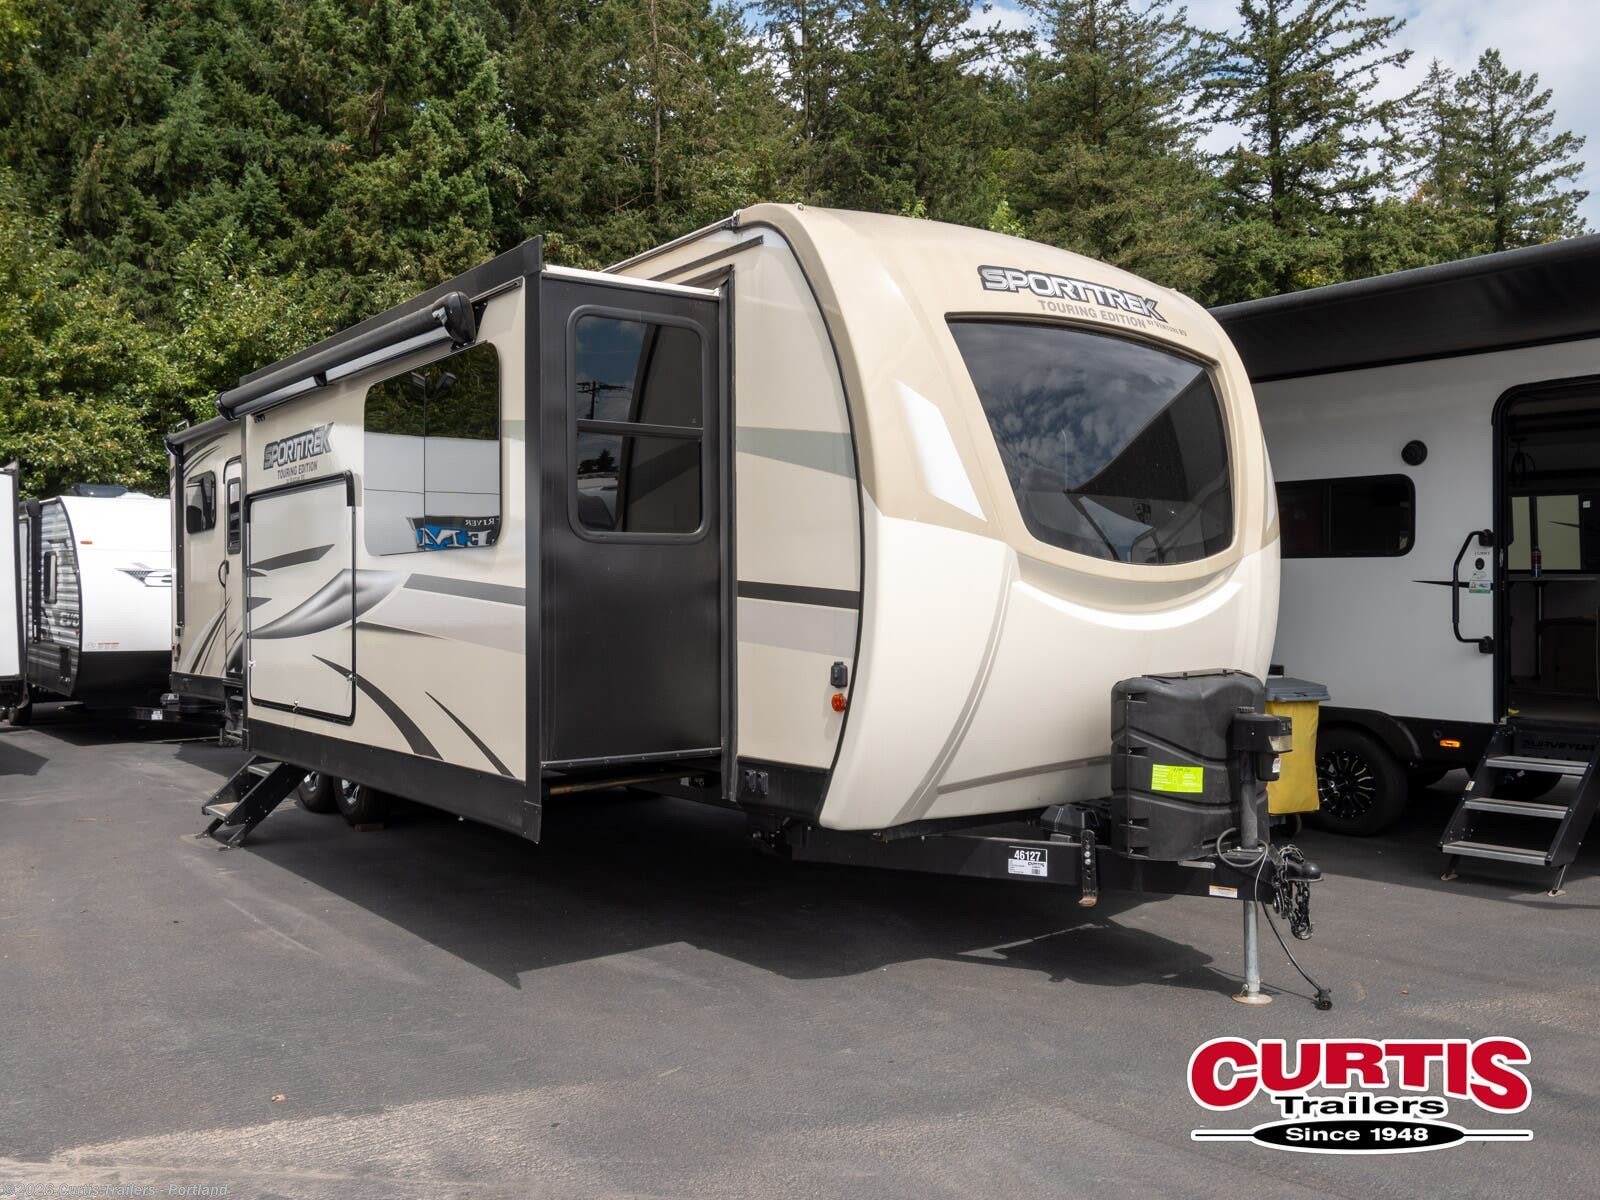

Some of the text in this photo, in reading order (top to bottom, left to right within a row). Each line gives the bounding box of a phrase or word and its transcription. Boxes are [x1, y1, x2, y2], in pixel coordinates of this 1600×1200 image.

[977, 264, 1168, 323] SPORTTREK
[1037, 300, 1146, 329] TOURING EDITION
[263, 422, 334, 470] SPORTTREK
[277, 466, 298, 480] TOURING
[298, 461, 319, 475] EDITION
[1013, 850, 1041, 862] 46127
